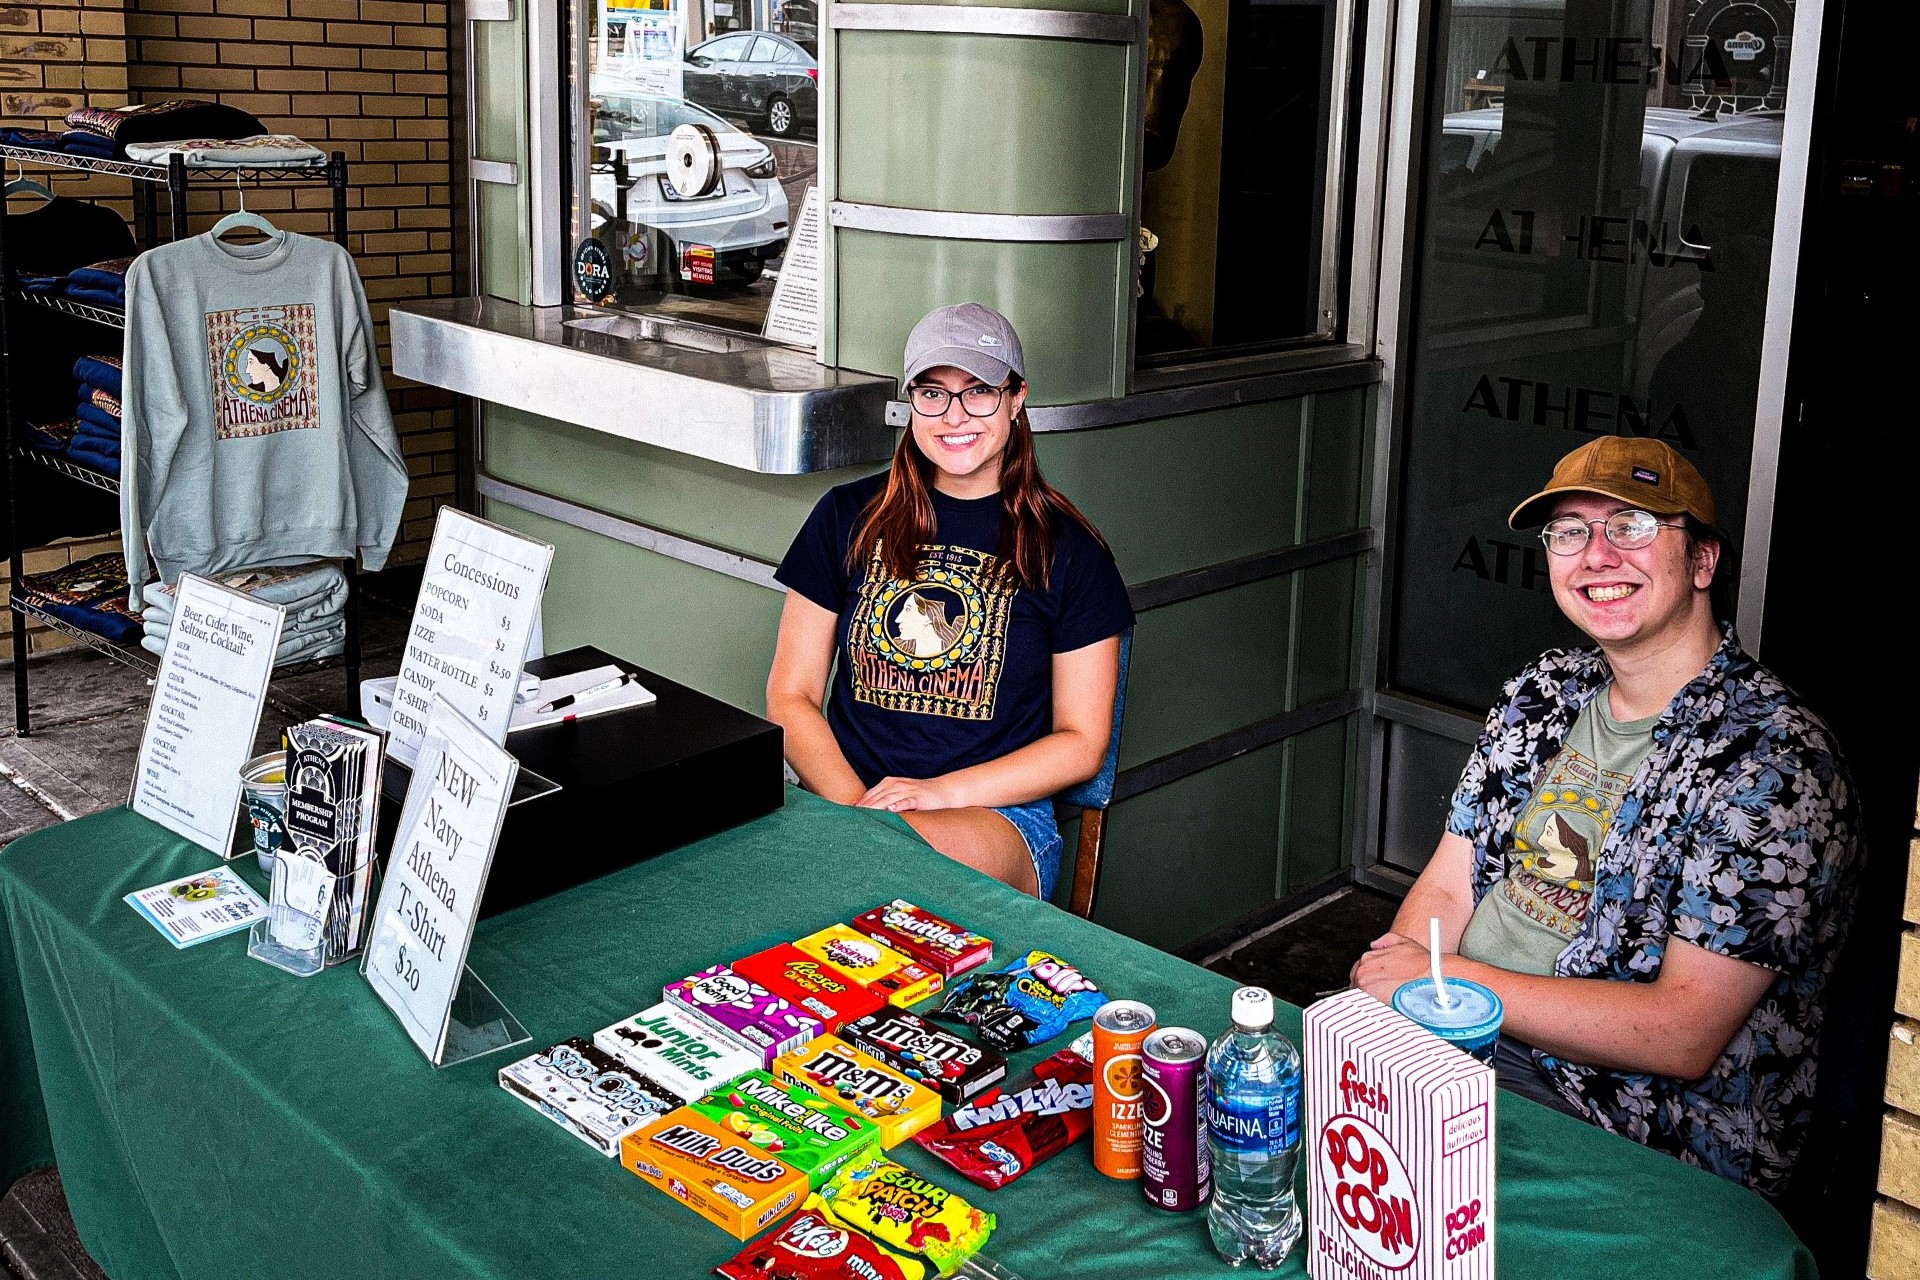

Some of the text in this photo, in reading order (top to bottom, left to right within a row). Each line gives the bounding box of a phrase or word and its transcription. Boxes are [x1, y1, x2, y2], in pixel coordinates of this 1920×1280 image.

[1490, 36, 1732, 88] ATHENA
[1474, 208, 1715, 272] ATHENA
[577, 261, 610, 279] DORA
[222, 386, 310, 431] ATHENA CINEMA
[1462, 374, 1700, 451] ATHENA
[444, 552, 520, 601] Concessions
[946, 553, 963, 563] 1915
[182, 605, 254, 646] Beer, Cider, Wine,
[425, 581, 511, 632] POPCORN $3
[179, 619, 209, 644] Seltzer,
[210, 631, 247, 657] Cocktail:
[419, 603, 506, 652] SODA $2
[409, 645, 494, 697] WATER BOTTLE $2
[413, 624, 511, 680] IZZE $2.50
[403, 667, 488, 721] CANDY $3
[858, 644, 984, 707] ATHENA CINEMA
[160, 704, 186, 721] COCKTAIL
[152, 737, 177, 754] COCKTAIL
[303, 754, 326, 769] ATHENA
[435, 751, 480, 810] NEW
[291, 798, 334, 819] MEMBERSHIP
[295, 811, 328, 829] PROGRAM
[423, 796, 464, 862] Navy
[406, 840, 457, 913] Athena
[396, 881, 448, 962] T-Shirt
[881, 910, 968, 950] Skittles
[394, 942, 420, 992] $20
[825, 938, 878, 968] Raisinets
[713, 977, 747, 995] Good
[634, 1015, 723, 1062] Junior
[656, 1046, 713, 1081] Mints
[1339, 1060, 1389, 1115] fresh
[736, 1077, 802, 1119] Mike
[802, 1111, 849, 1141] Ike
[749, 1103, 805, 1135] Original Fruits
[1111, 1102, 1144, 1120] IZZE
[1448, 1114, 1482, 1136] delicious
[652, 1124, 787, 1181] Milk Duds
[1326, 1123, 1389, 1195] POP
[1446, 1127, 1484, 1151] nutritious
[757, 1207, 775, 1228] Milk
[775, 1190, 798, 1212] Duds
[862, 1180, 940, 1219] PATCH
[879, 1170, 950, 1207] SOUR
[879, 1202, 909, 1222] Kids
[1335, 1181, 1414, 1256] CORN
[1445, 1198, 1482, 1237] POP
[1445, 1222, 1486, 1261] CORN
